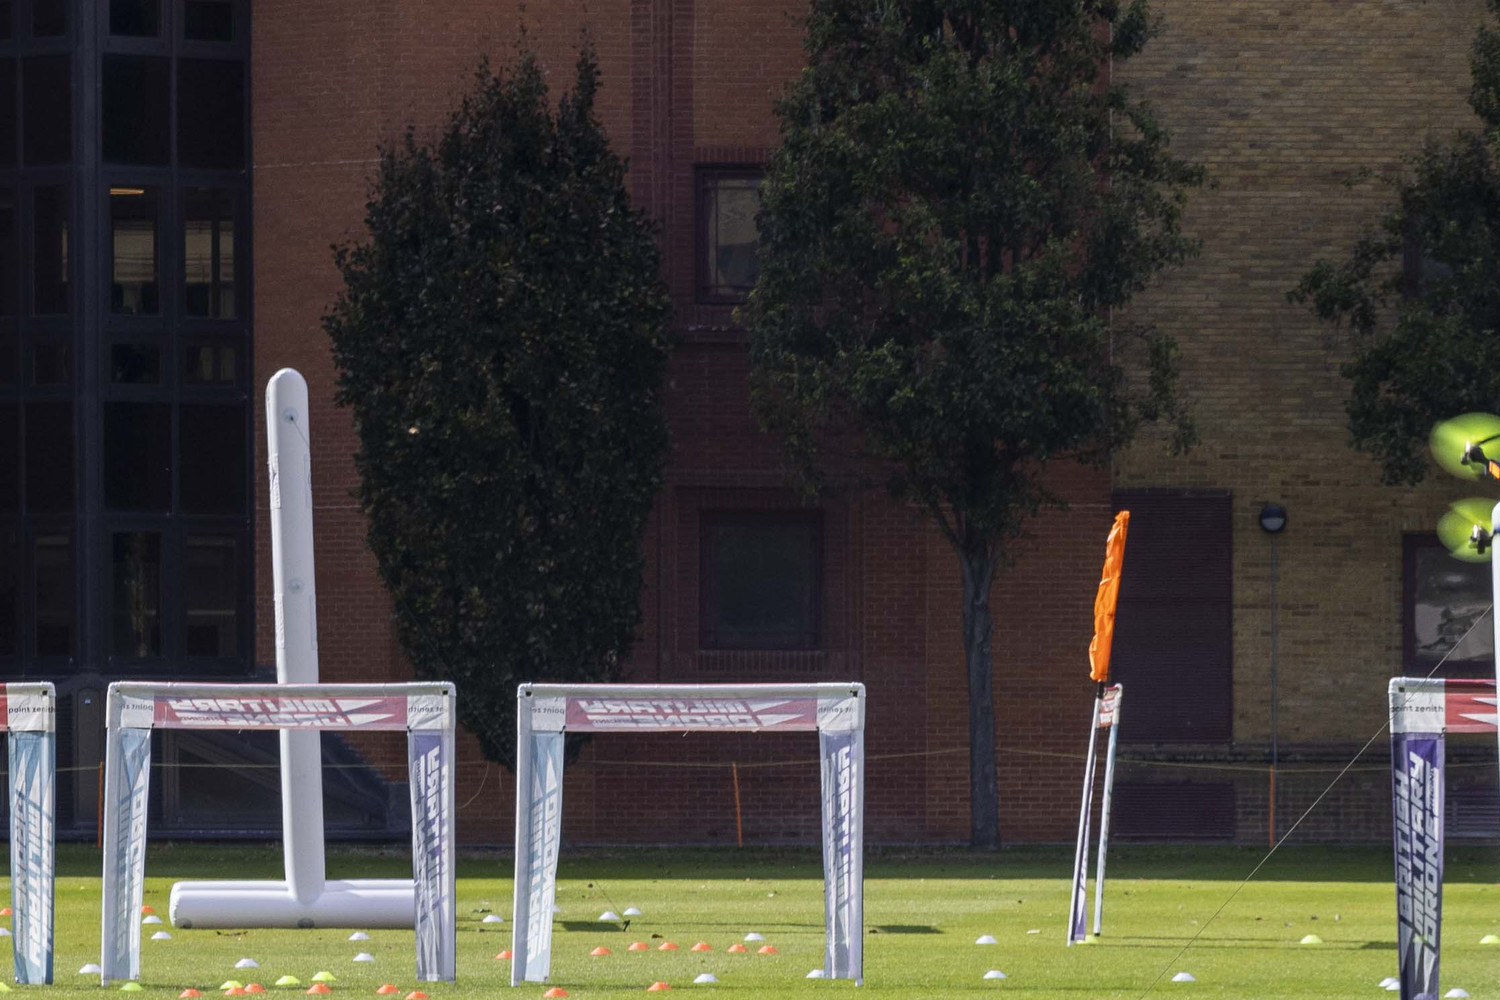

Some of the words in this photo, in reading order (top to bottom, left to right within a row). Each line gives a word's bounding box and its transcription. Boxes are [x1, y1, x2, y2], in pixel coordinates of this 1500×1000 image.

[1415, 704, 1444, 712] zenith
[28, 805, 41, 968] MILITARY
[1396, 769, 1413, 926] BRITISH
[1409, 751, 1425, 936] MILITARY
[1424, 808, 1439, 948] DRONE
